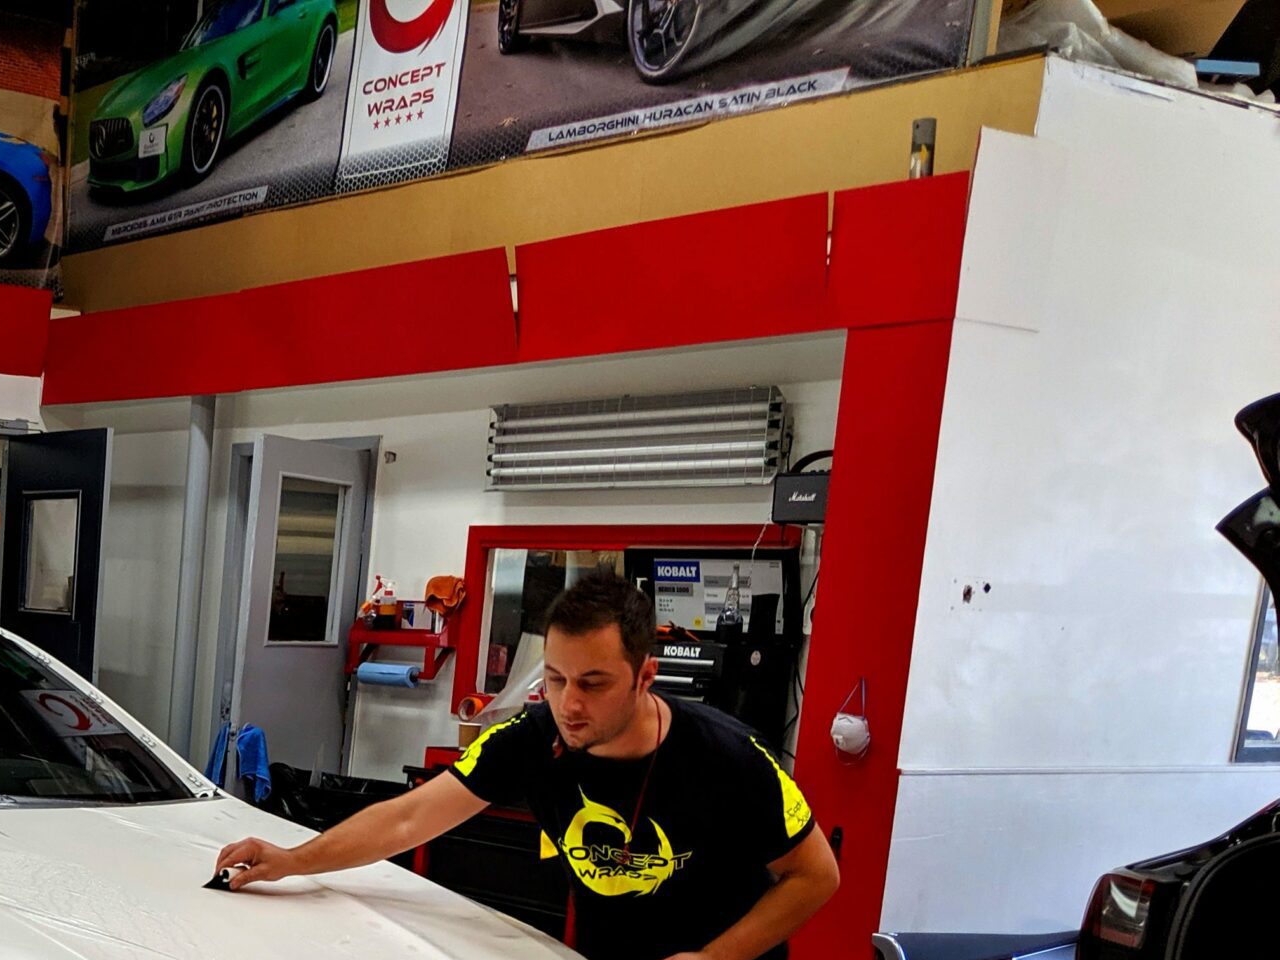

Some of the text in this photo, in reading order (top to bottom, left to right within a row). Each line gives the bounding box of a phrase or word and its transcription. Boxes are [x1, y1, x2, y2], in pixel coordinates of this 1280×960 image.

[362, 62, 446, 95] CONCEPT
[367, 88, 434, 117] WRAPS
[548, 79, 817, 141] LAMBORGHINI HURACAN SATIN BLACK
[657, 566, 697, 578] KOBALT
[663, 646, 701, 657] KOBALT
